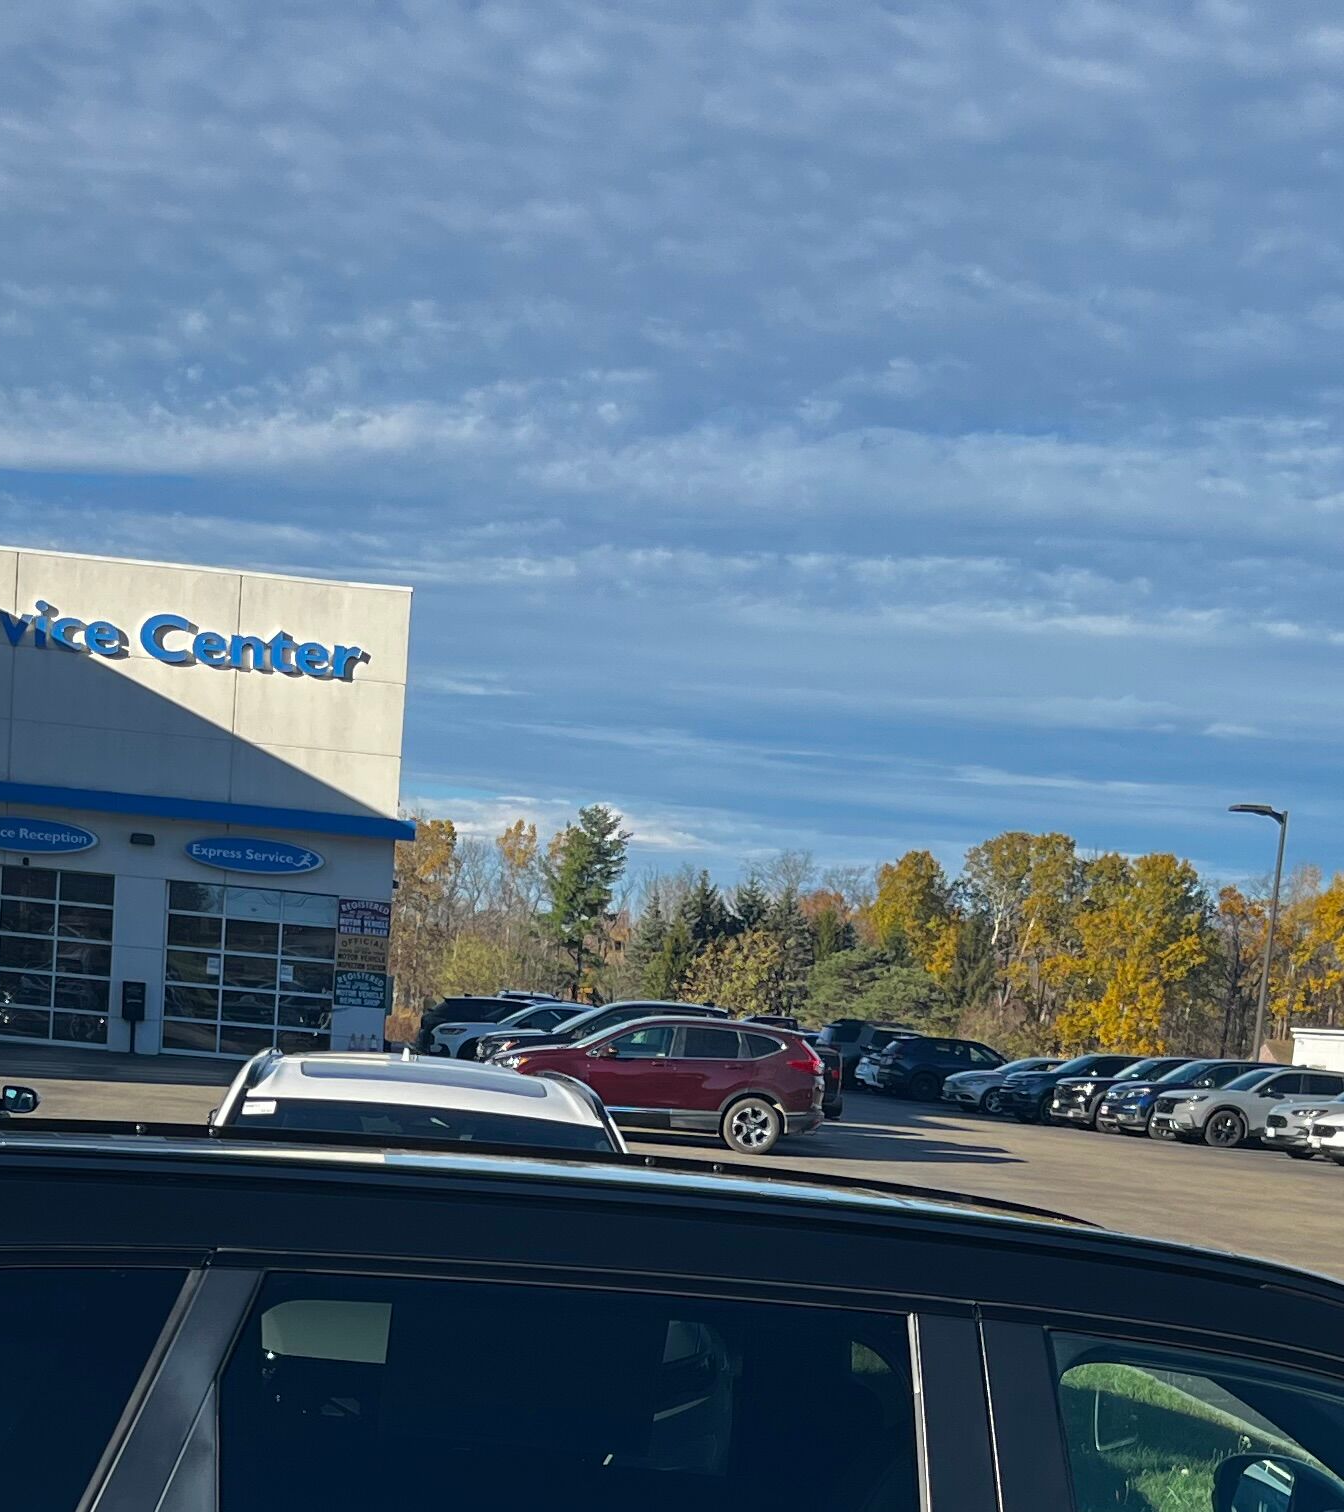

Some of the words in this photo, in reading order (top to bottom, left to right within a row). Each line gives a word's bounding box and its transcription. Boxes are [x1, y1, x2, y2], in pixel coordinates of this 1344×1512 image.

[139, 612, 366, 680] Center
[19, 828, 87, 844] Reception
[192, 843, 242, 859] Express
[245, 849, 294, 864] Service
[341, 901, 390, 915] REGISTERED
[341, 938, 385, 951] OFFICIAL
[337, 972, 385, 987] REGISTERED
